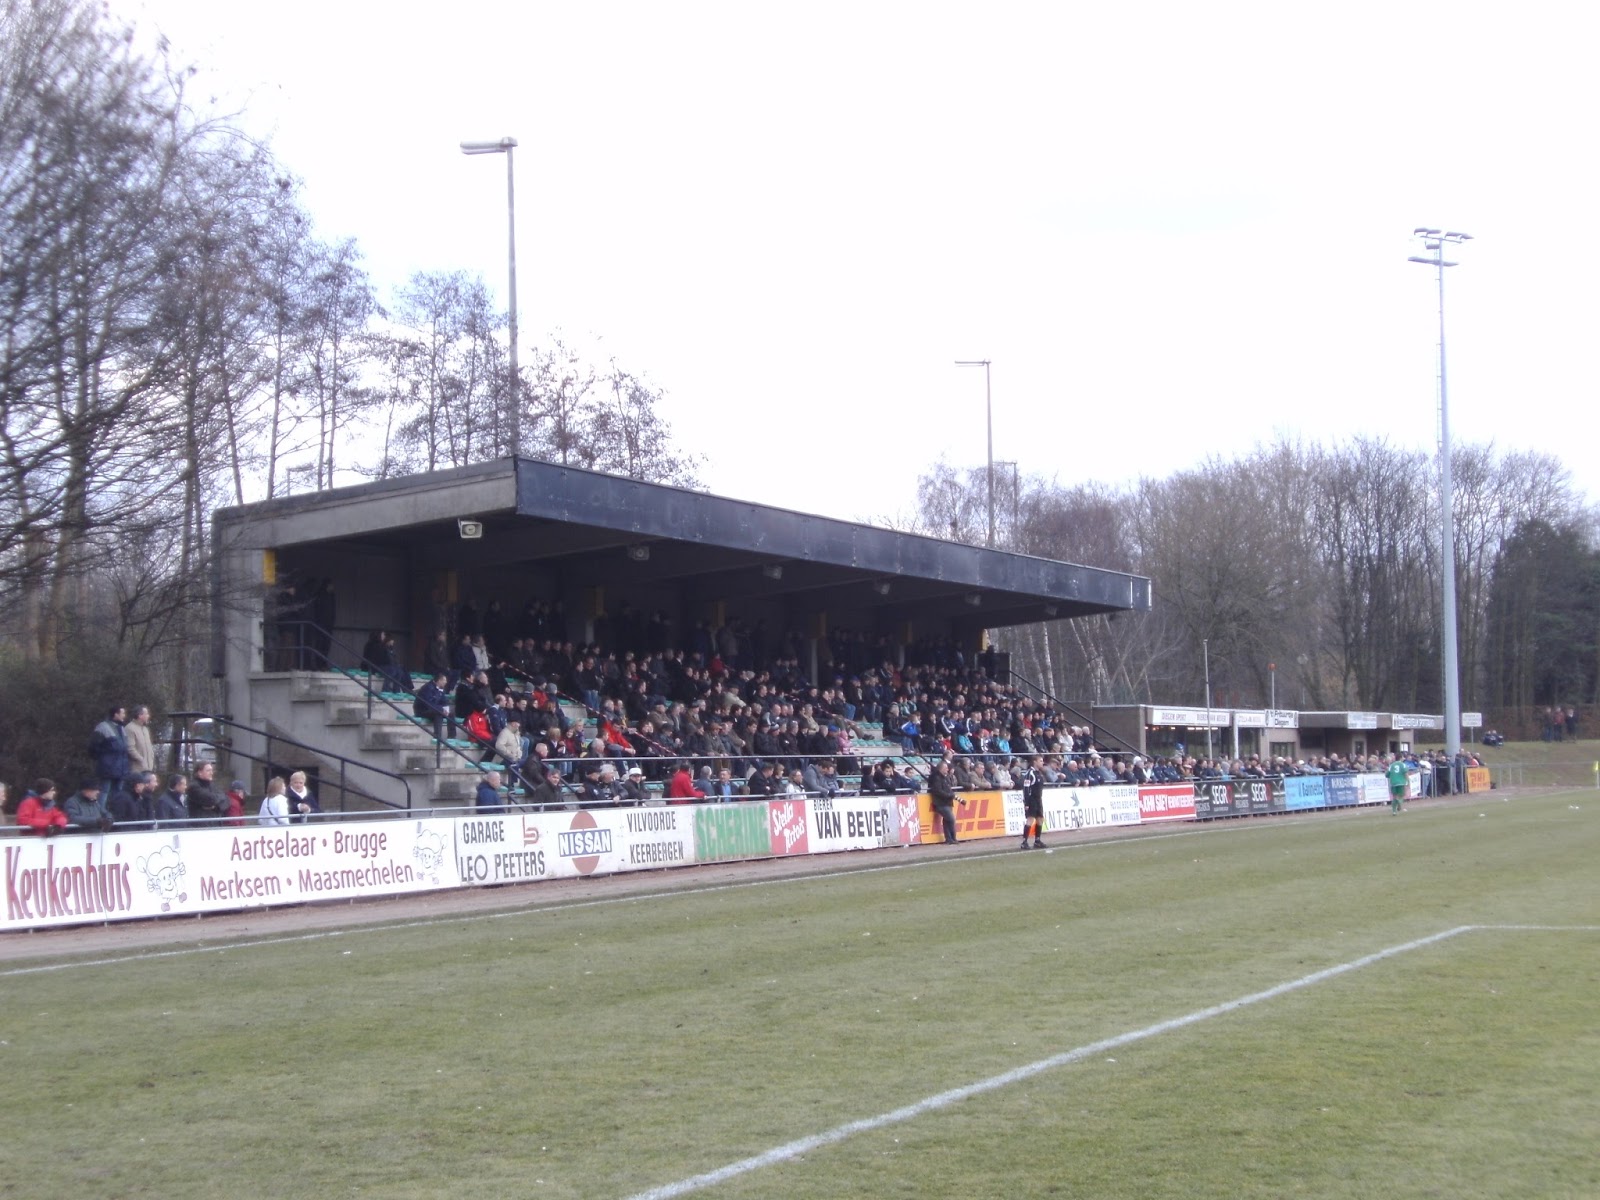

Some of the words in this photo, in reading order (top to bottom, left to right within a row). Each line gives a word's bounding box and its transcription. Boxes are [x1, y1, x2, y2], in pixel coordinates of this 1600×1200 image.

[1394, 765, 1400, 773] 3
[627, 810, 677, 832] VILVOORDE
[772, 801, 794, 836] Stella
[815, 811, 842, 839] VAN
[898, 797, 917, 828] Stella
[230, 830, 316, 861] Aartselaar
[334, 830, 387, 858] Brugge
[463, 820, 505, 844] GARAGE
[559, 829, 612, 857] NISSAN
[695, 804, 770, 860] SCHERING
[783, 817, 805, 853] Artois
[460, 854, 489, 882] LEO
[494, 850, 546, 881] PEETERS
[630, 840, 684, 864] KEERBERGEN
[5, 842, 132, 921] Keukenhuis
[200, 871, 282, 901] Merksem
[299, 859, 414, 893] Maasmechelen
